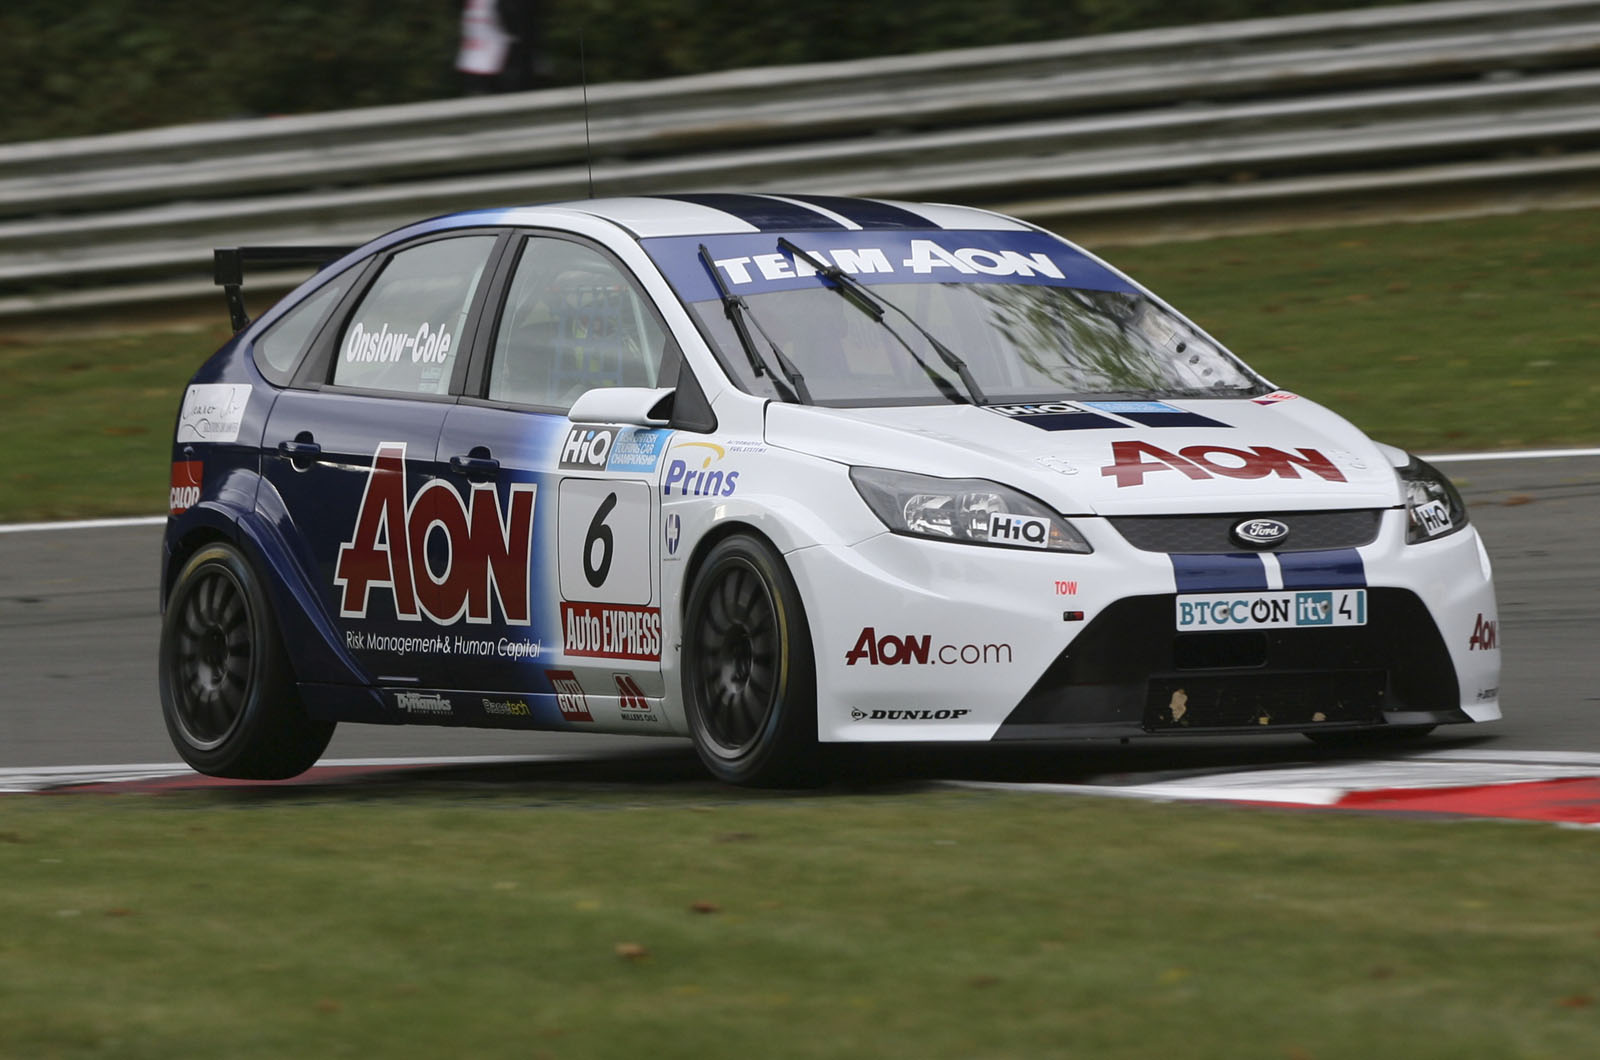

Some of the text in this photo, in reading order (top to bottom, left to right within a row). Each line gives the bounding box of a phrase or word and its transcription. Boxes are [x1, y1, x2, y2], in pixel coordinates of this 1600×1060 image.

[715, 248, 894, 285] TEAM
[346, 321, 451, 364] Onslow-Cole
[562, 430, 613, 466] HiQ
[1101, 440, 1348, 488] AON
[664, 457, 739, 496] Prins
[333, 441, 538, 626] AON
[991, 514, 1046, 544] HiQ
[1249, 521, 1280, 537] Ford
[1419, 505, 1449, 531] HiQ
[583, 492, 618, 588] 6
[1055, 581, 1077, 595] TOW
[1338, 594, 1353, 620] 4
[346, 631, 364, 649] Risk
[367, 633, 441, 655] Management
[454, 636, 494, 655] Human
[498, 637, 541, 661] Capital
[566, 608, 661, 655] Auto EXPRESS
[870, 709, 968, 719] DUNLOP
